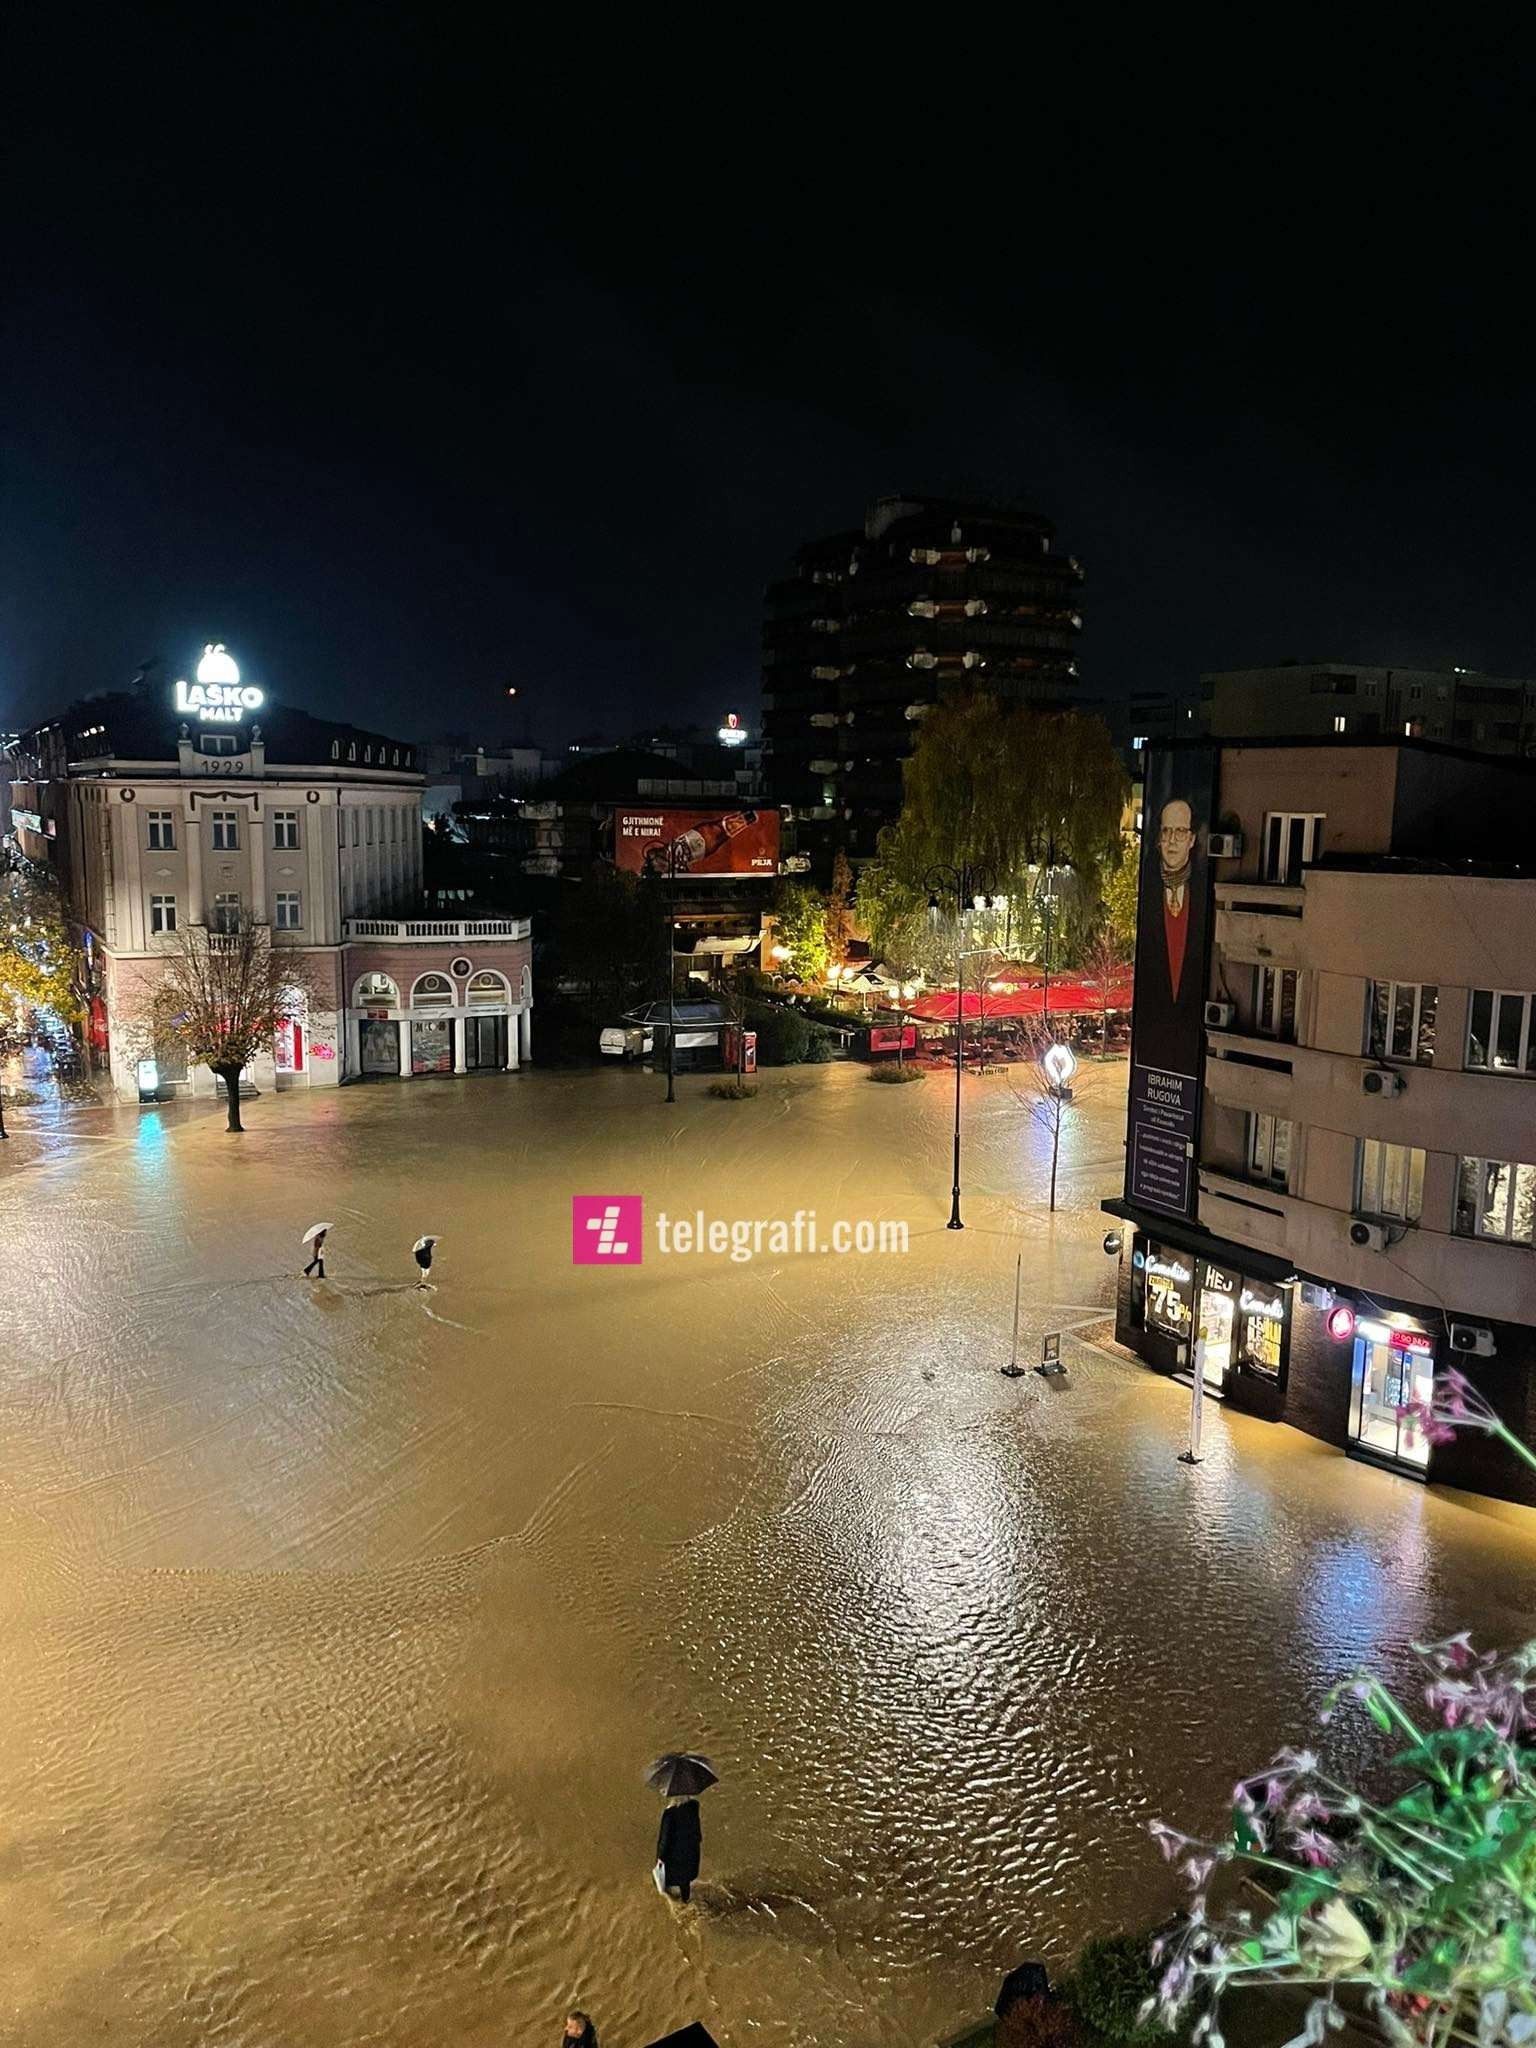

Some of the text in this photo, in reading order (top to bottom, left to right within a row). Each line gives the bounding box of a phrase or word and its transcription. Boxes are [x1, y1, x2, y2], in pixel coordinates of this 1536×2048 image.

[200, 706, 243, 722] MALT
[201, 760, 244, 774] 1929
[634, 827, 640, 837] E
[1147, 1073, 1183, 1091] IBRAHIM
[1147, 1087, 1181, 1106] RUGOVA
[1205, 1264, 1233, 1292] HEJ
